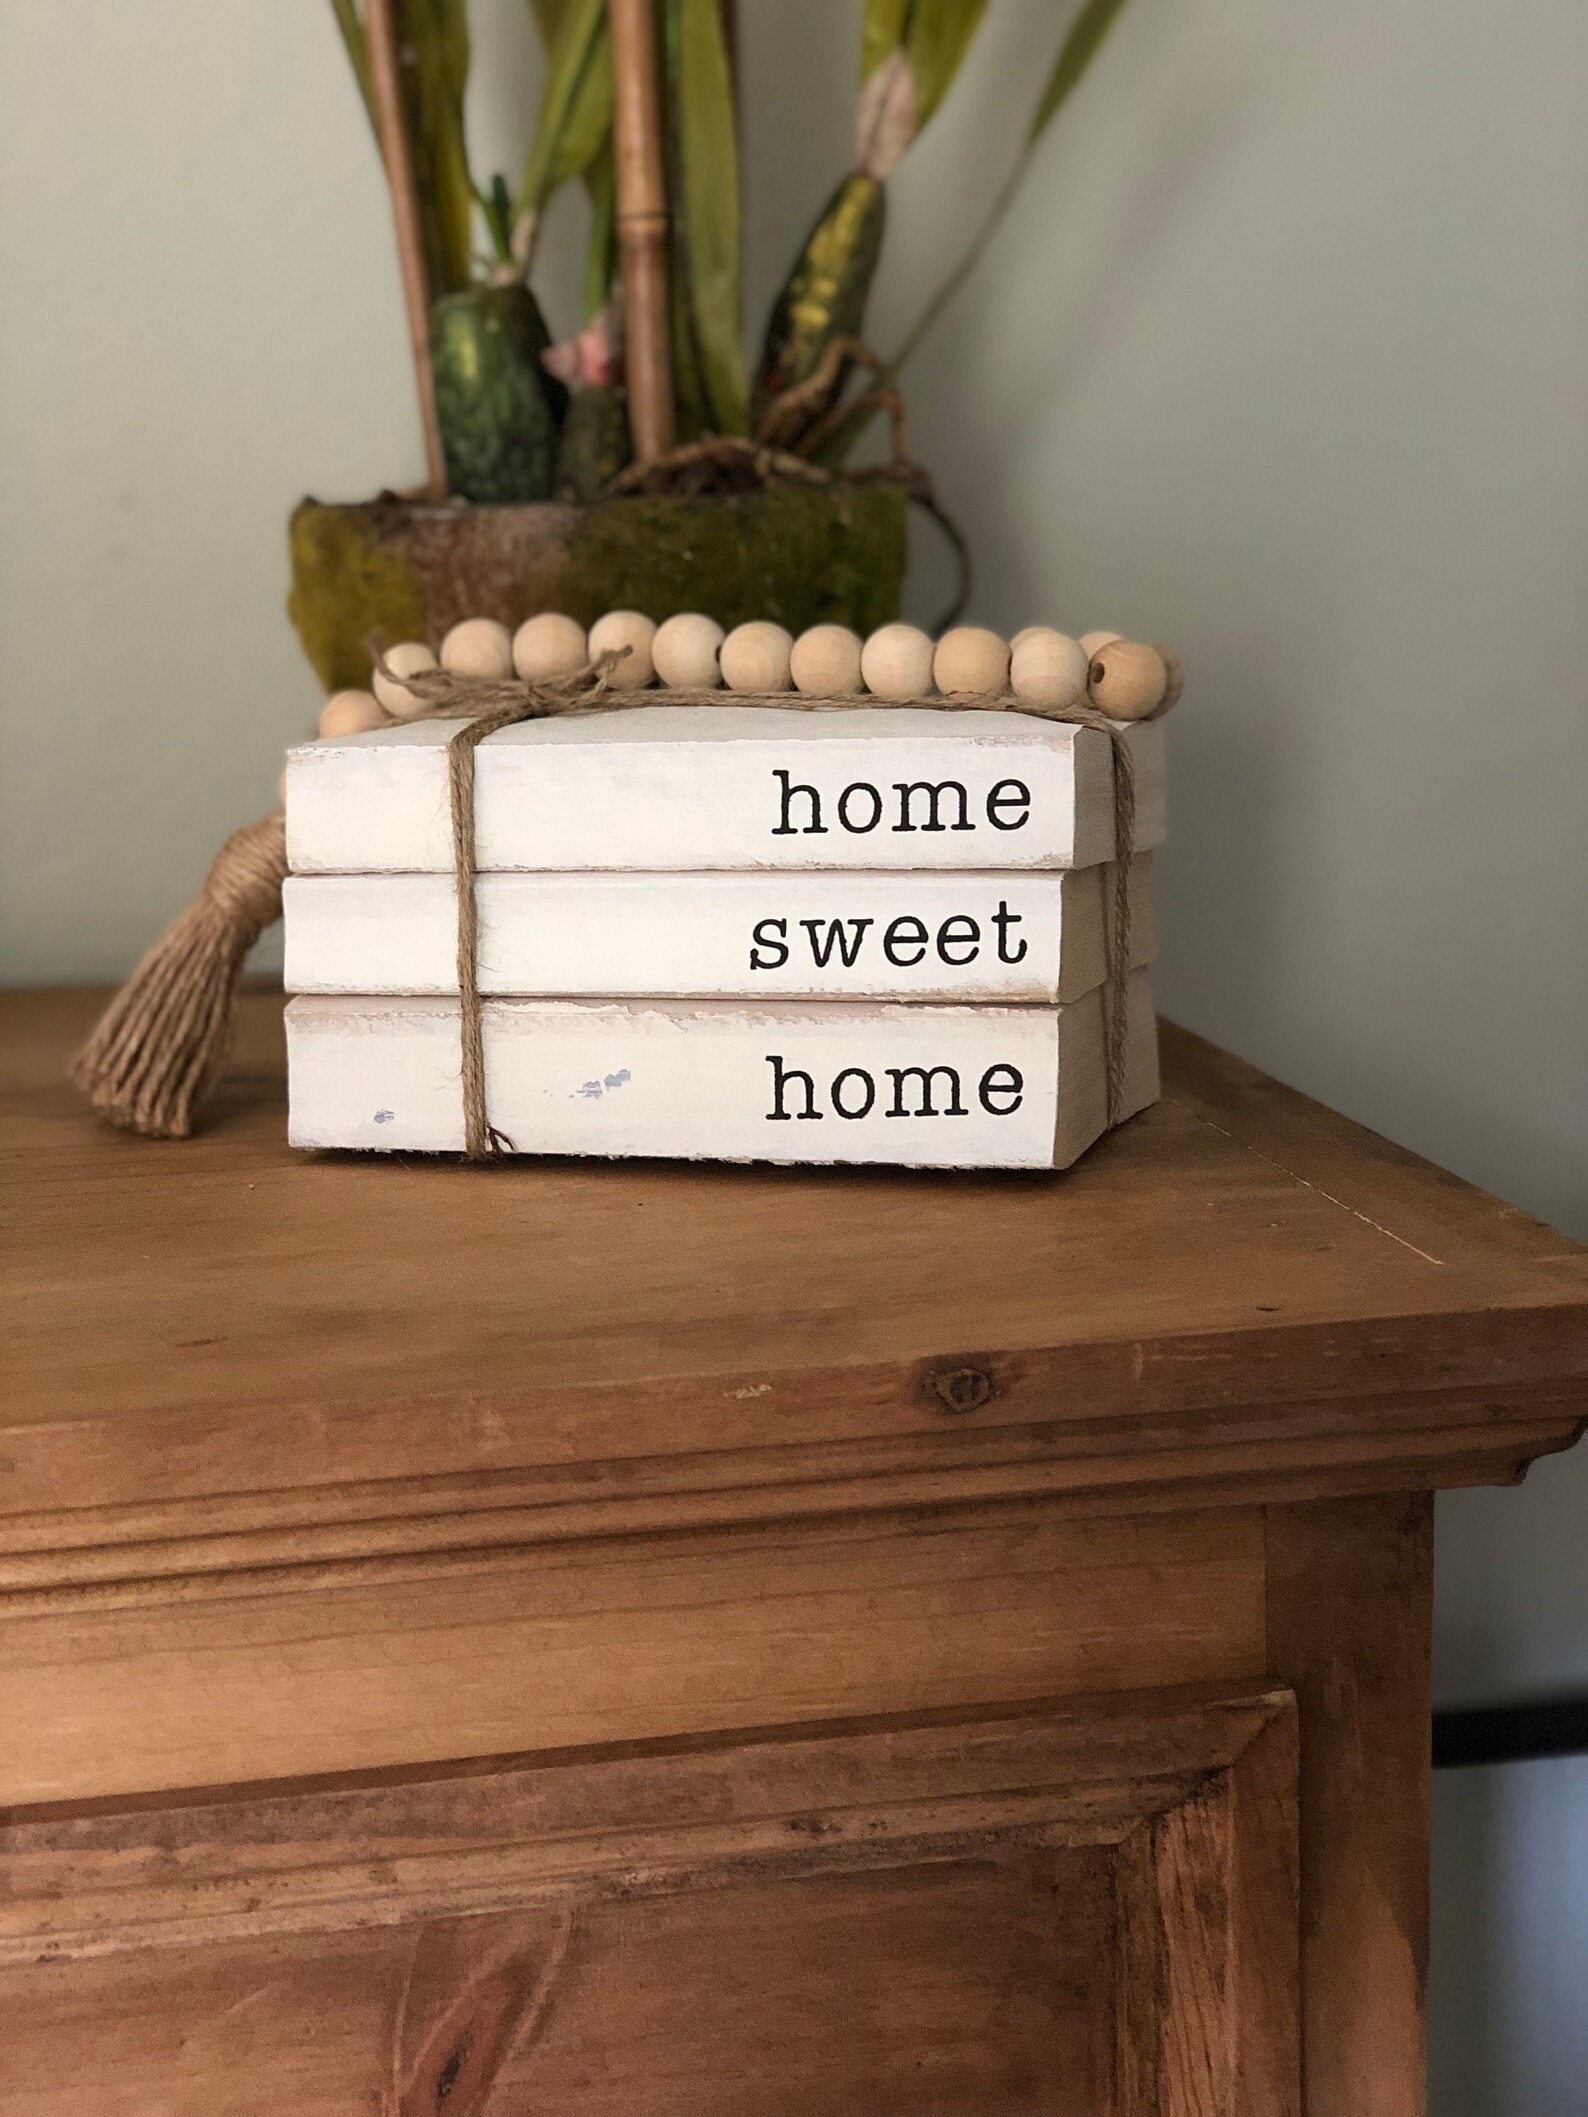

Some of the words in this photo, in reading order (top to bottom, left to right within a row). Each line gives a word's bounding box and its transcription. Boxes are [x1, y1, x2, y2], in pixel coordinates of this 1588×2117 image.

[771, 769, 1031, 836] home
[749, 900, 1028, 971] sweet
[765, 1055, 1024, 1121] home
